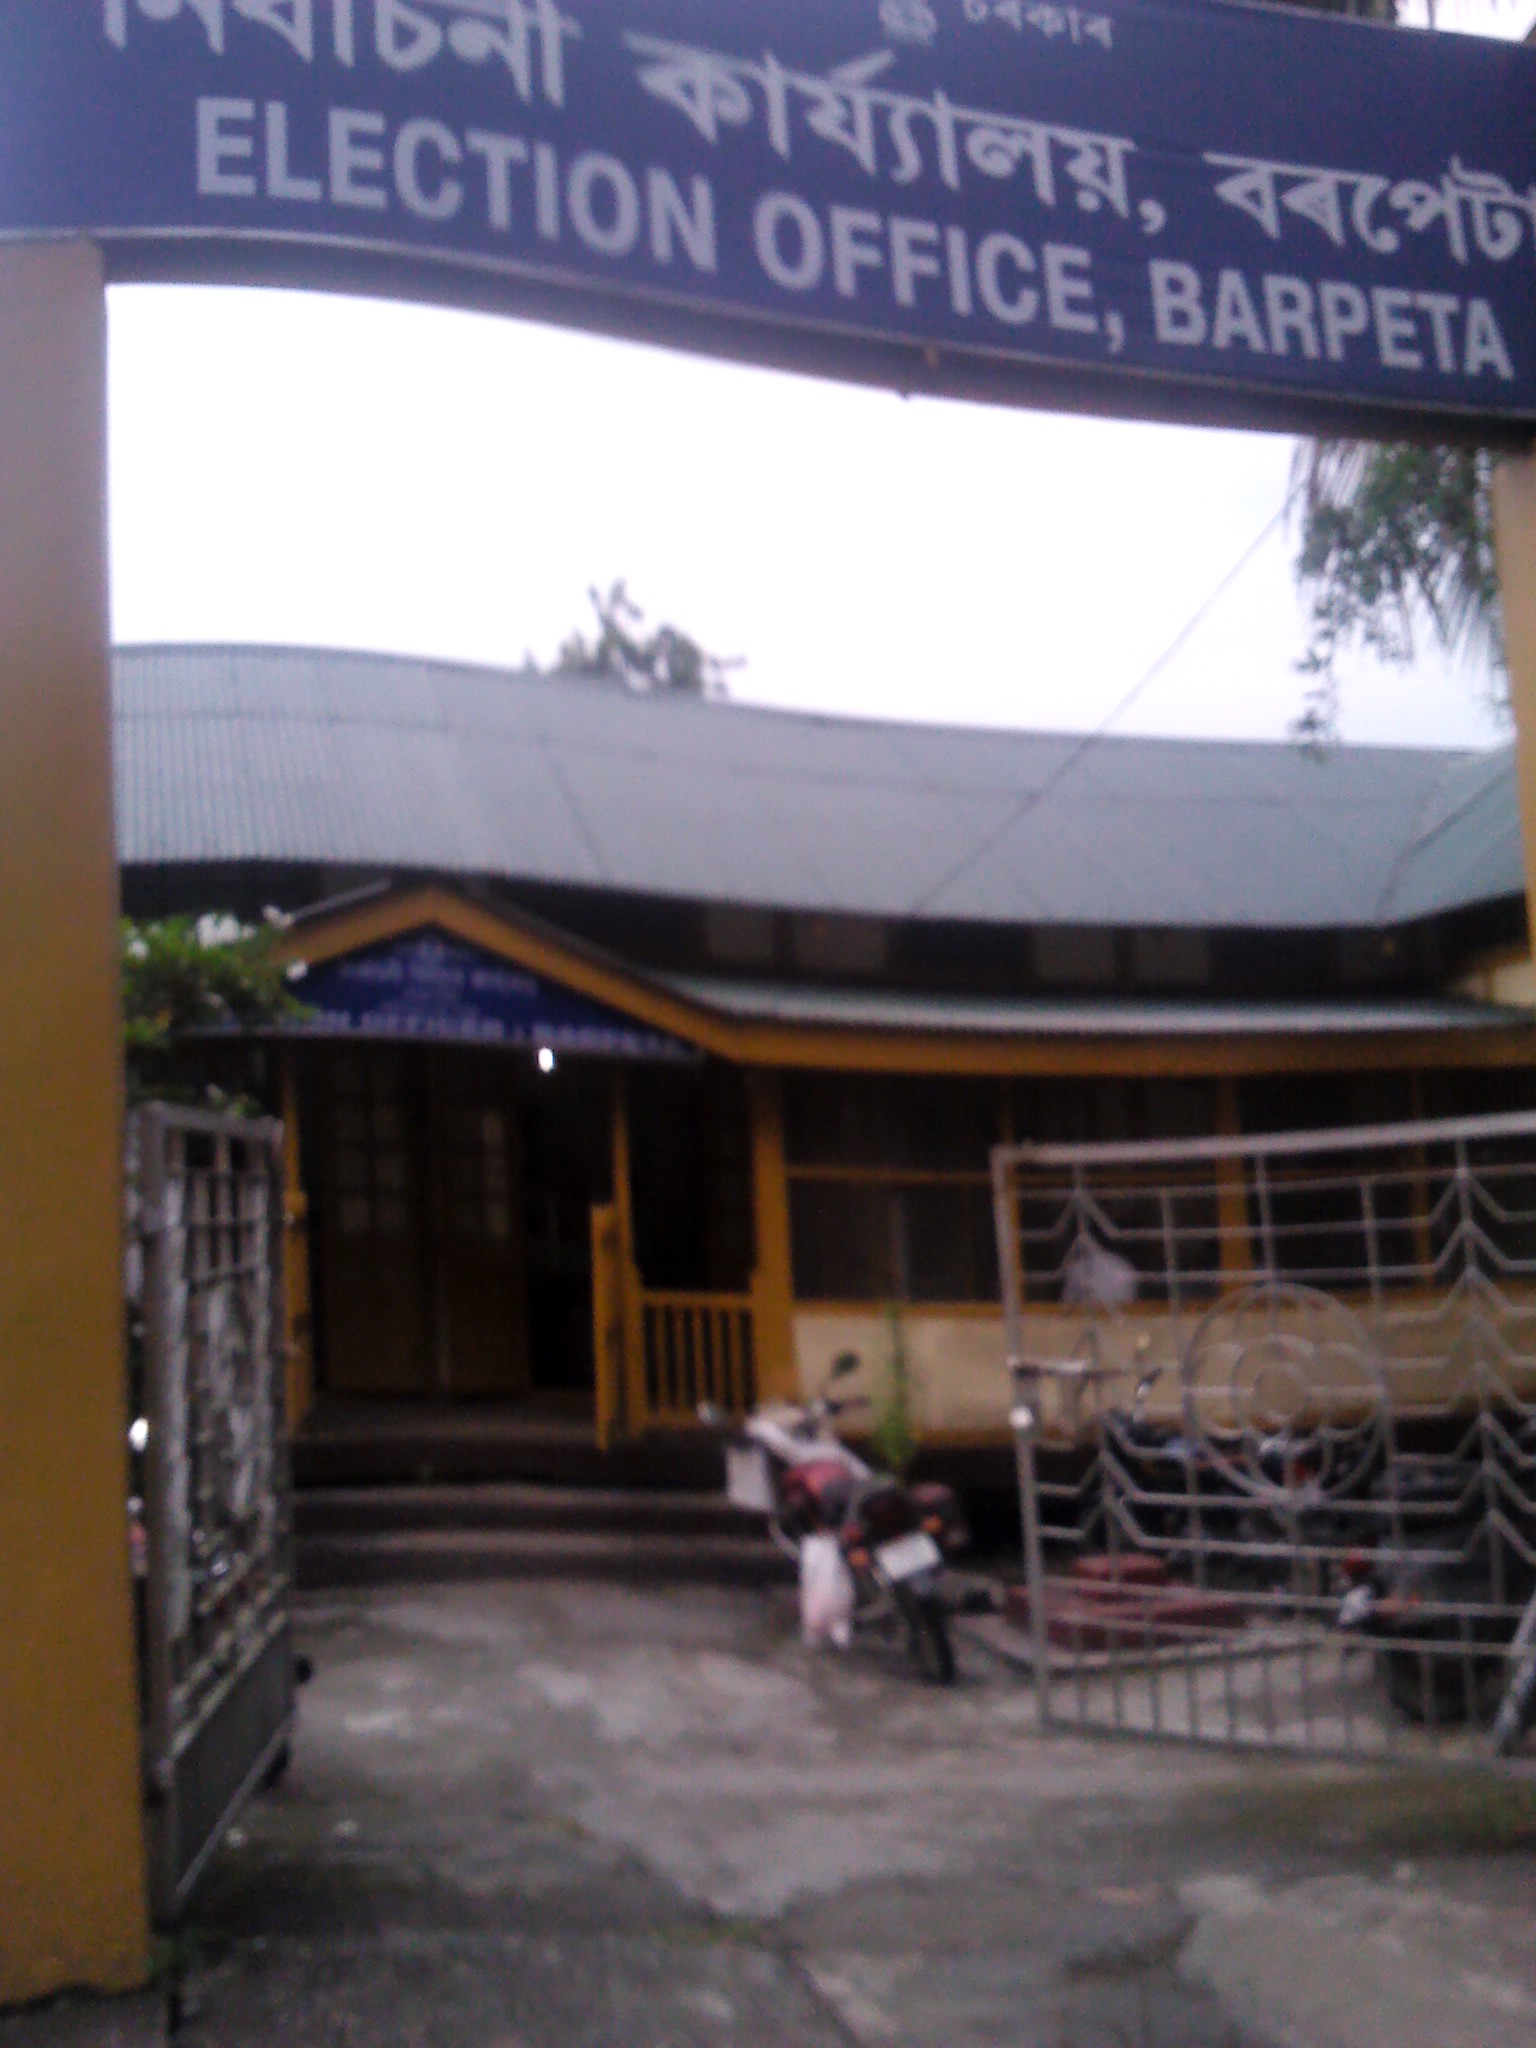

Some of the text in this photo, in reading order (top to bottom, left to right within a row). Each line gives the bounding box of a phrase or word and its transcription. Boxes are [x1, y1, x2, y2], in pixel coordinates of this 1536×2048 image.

[195, 97, 1516, 381] ELECTION OFFICE, BARPETA
